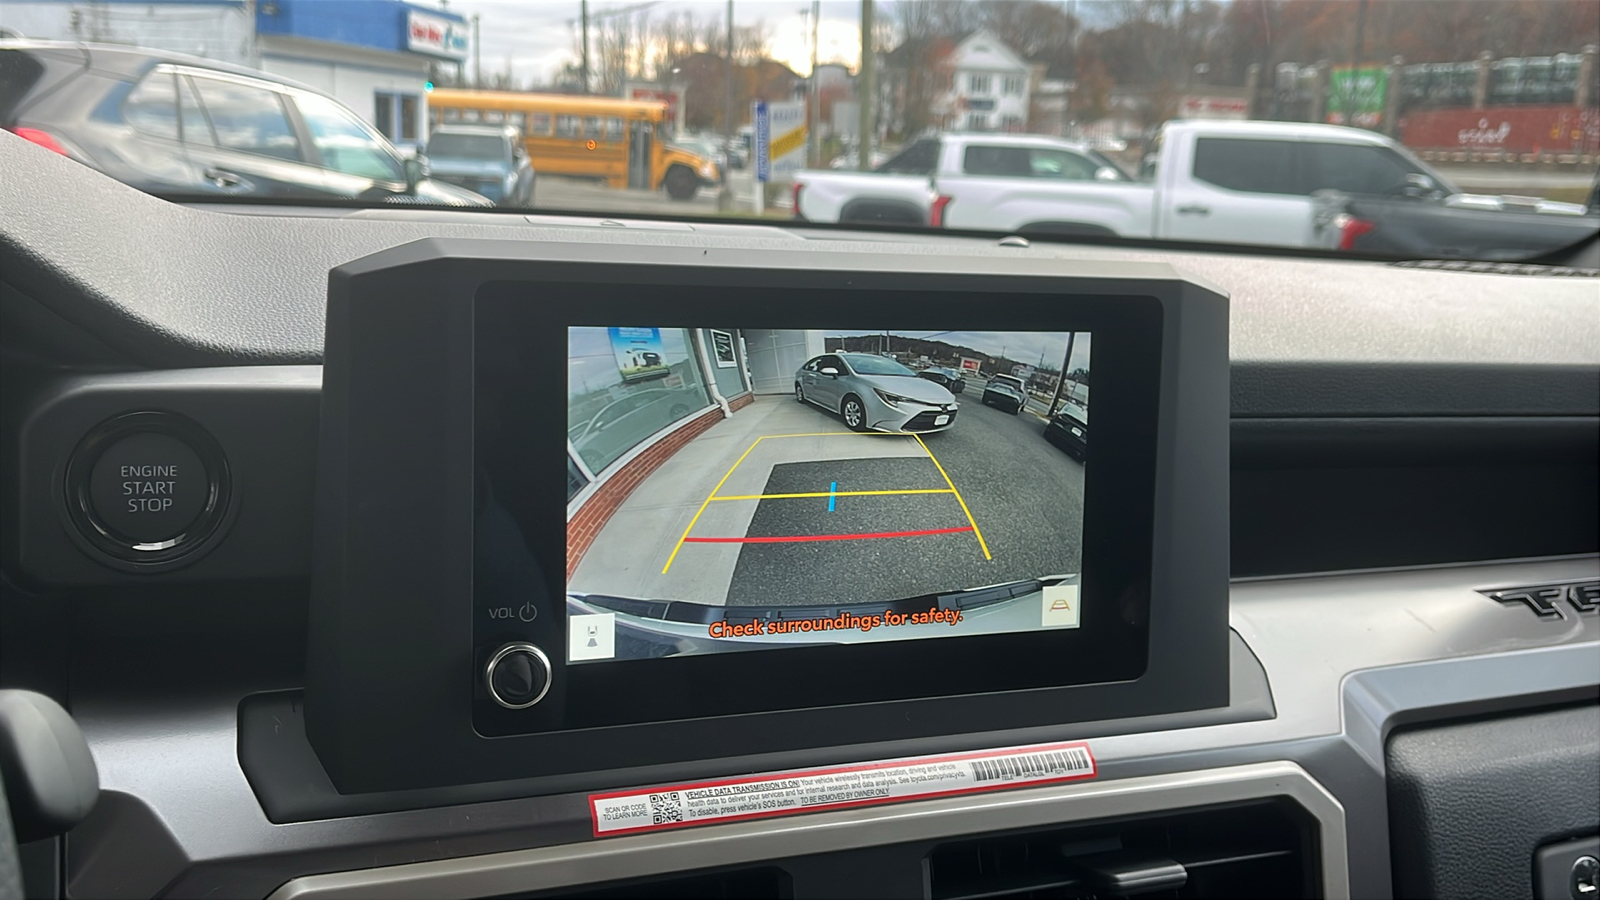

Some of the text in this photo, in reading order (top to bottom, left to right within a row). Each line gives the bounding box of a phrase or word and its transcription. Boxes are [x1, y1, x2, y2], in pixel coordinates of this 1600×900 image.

[121, 466, 177, 477] ENGINE
[123, 482, 176, 495] START
[128, 498, 172, 512] STOP
[489, 607, 515, 619] VOL
[709, 607, 963, 638] Check surroundings for safety.
[685, 789, 713, 799] VEHICLE
[714, 788, 731, 797] DATA
[732, 783, 779, 795] TRANSMISSION
[835, 774, 860, 782] wirelessly
[861, 770, 885, 779] transmits
[909, 766, 926, 774] driving
[748, 793, 760, 802] your
[827, 783, 850, 791] research
[876, 778, 898, 787] analysis.
[697, 807, 720, 816] disable,
[721, 806, 736, 815] press
[738, 801, 761, 811] vehicle's
[762, 800, 776, 808] SOS
[778, 799, 796, 807] button.
[818, 793, 845, 802] REMOVED
[854, 789, 874, 797] OWNER
[876, 788, 890, 796] ONLY
[612, 812, 631, 820] LEARN
